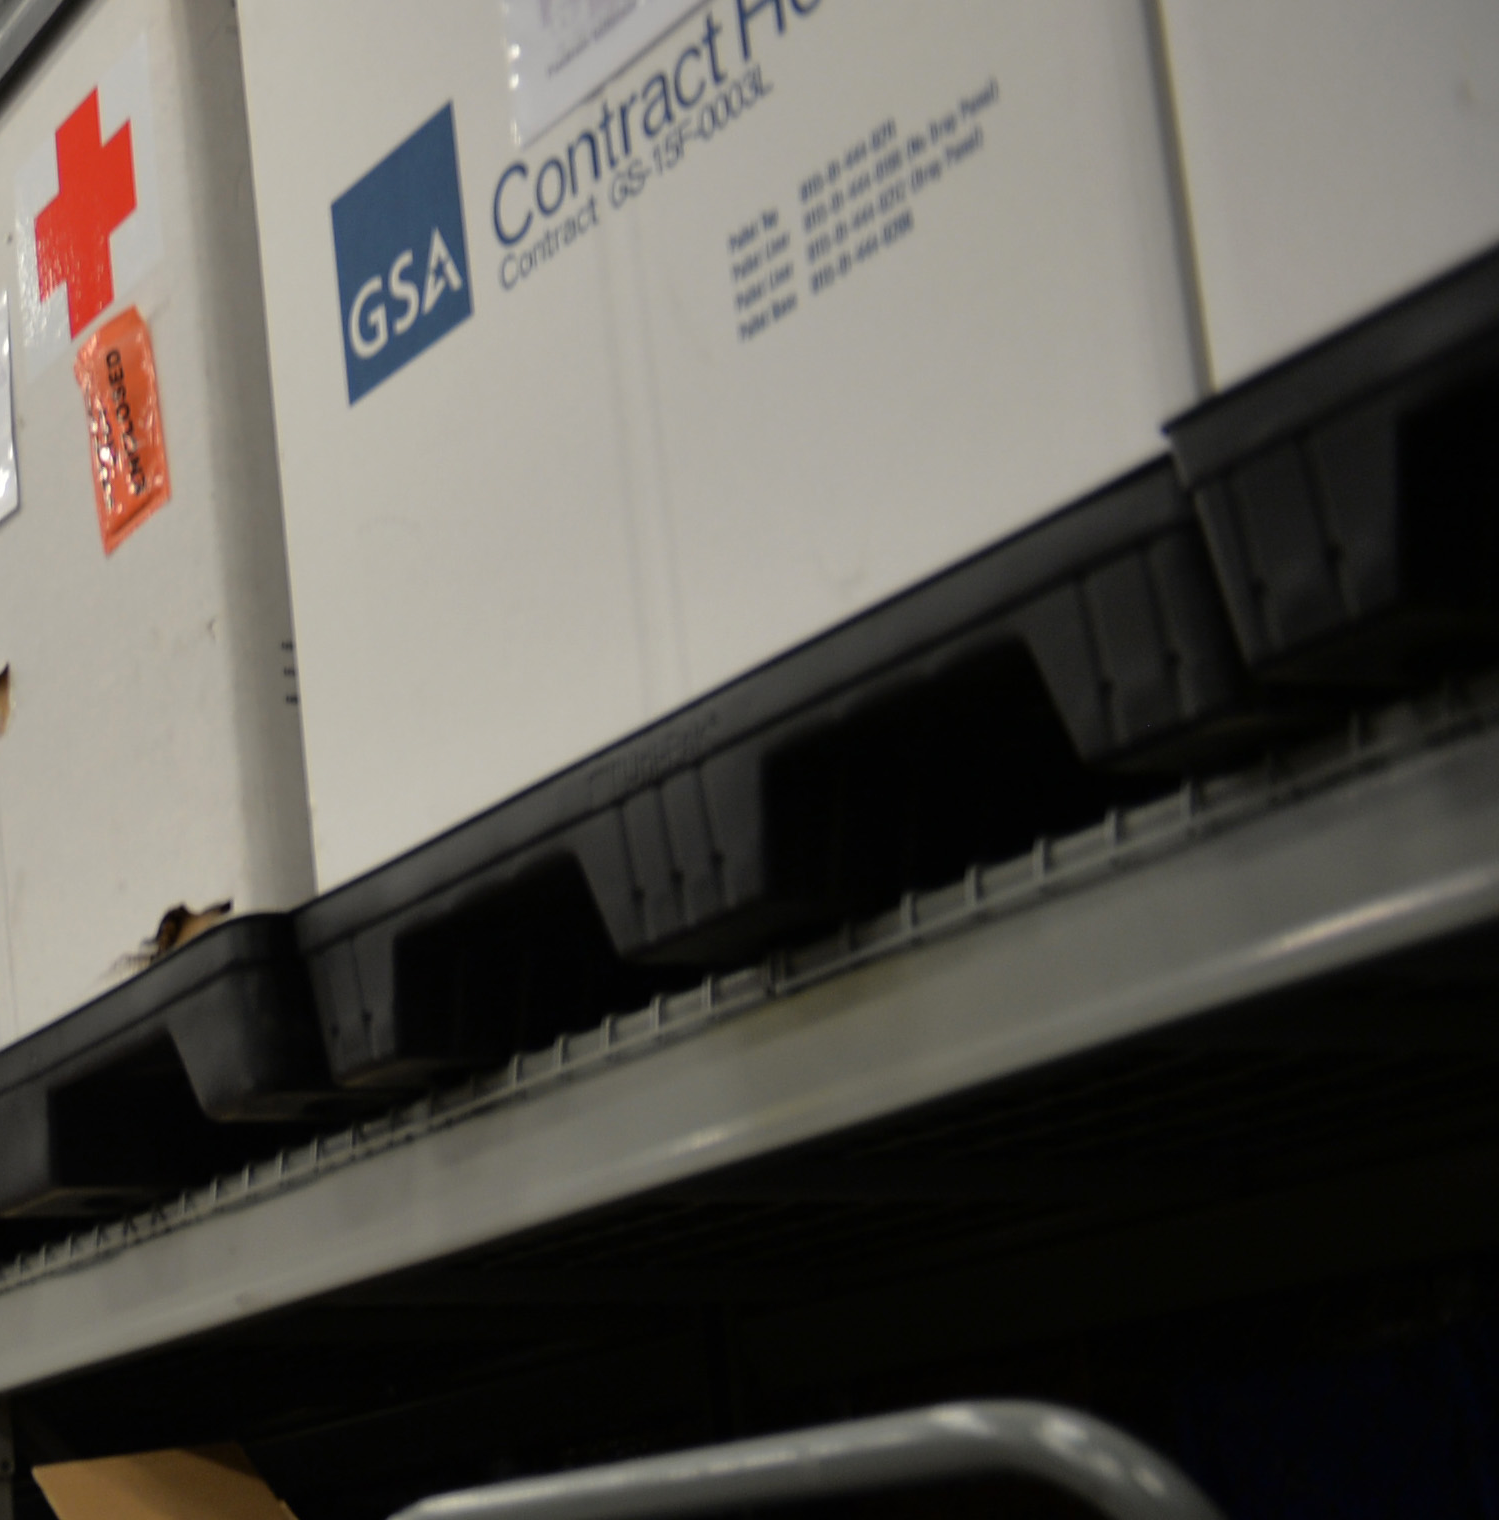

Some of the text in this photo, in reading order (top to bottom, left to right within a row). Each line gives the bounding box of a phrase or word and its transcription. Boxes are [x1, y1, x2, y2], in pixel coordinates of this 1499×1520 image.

[492, 11, 727, 246] Contract
[348, 225, 463, 360] GSA
[499, 196, 600, 291] Contract
